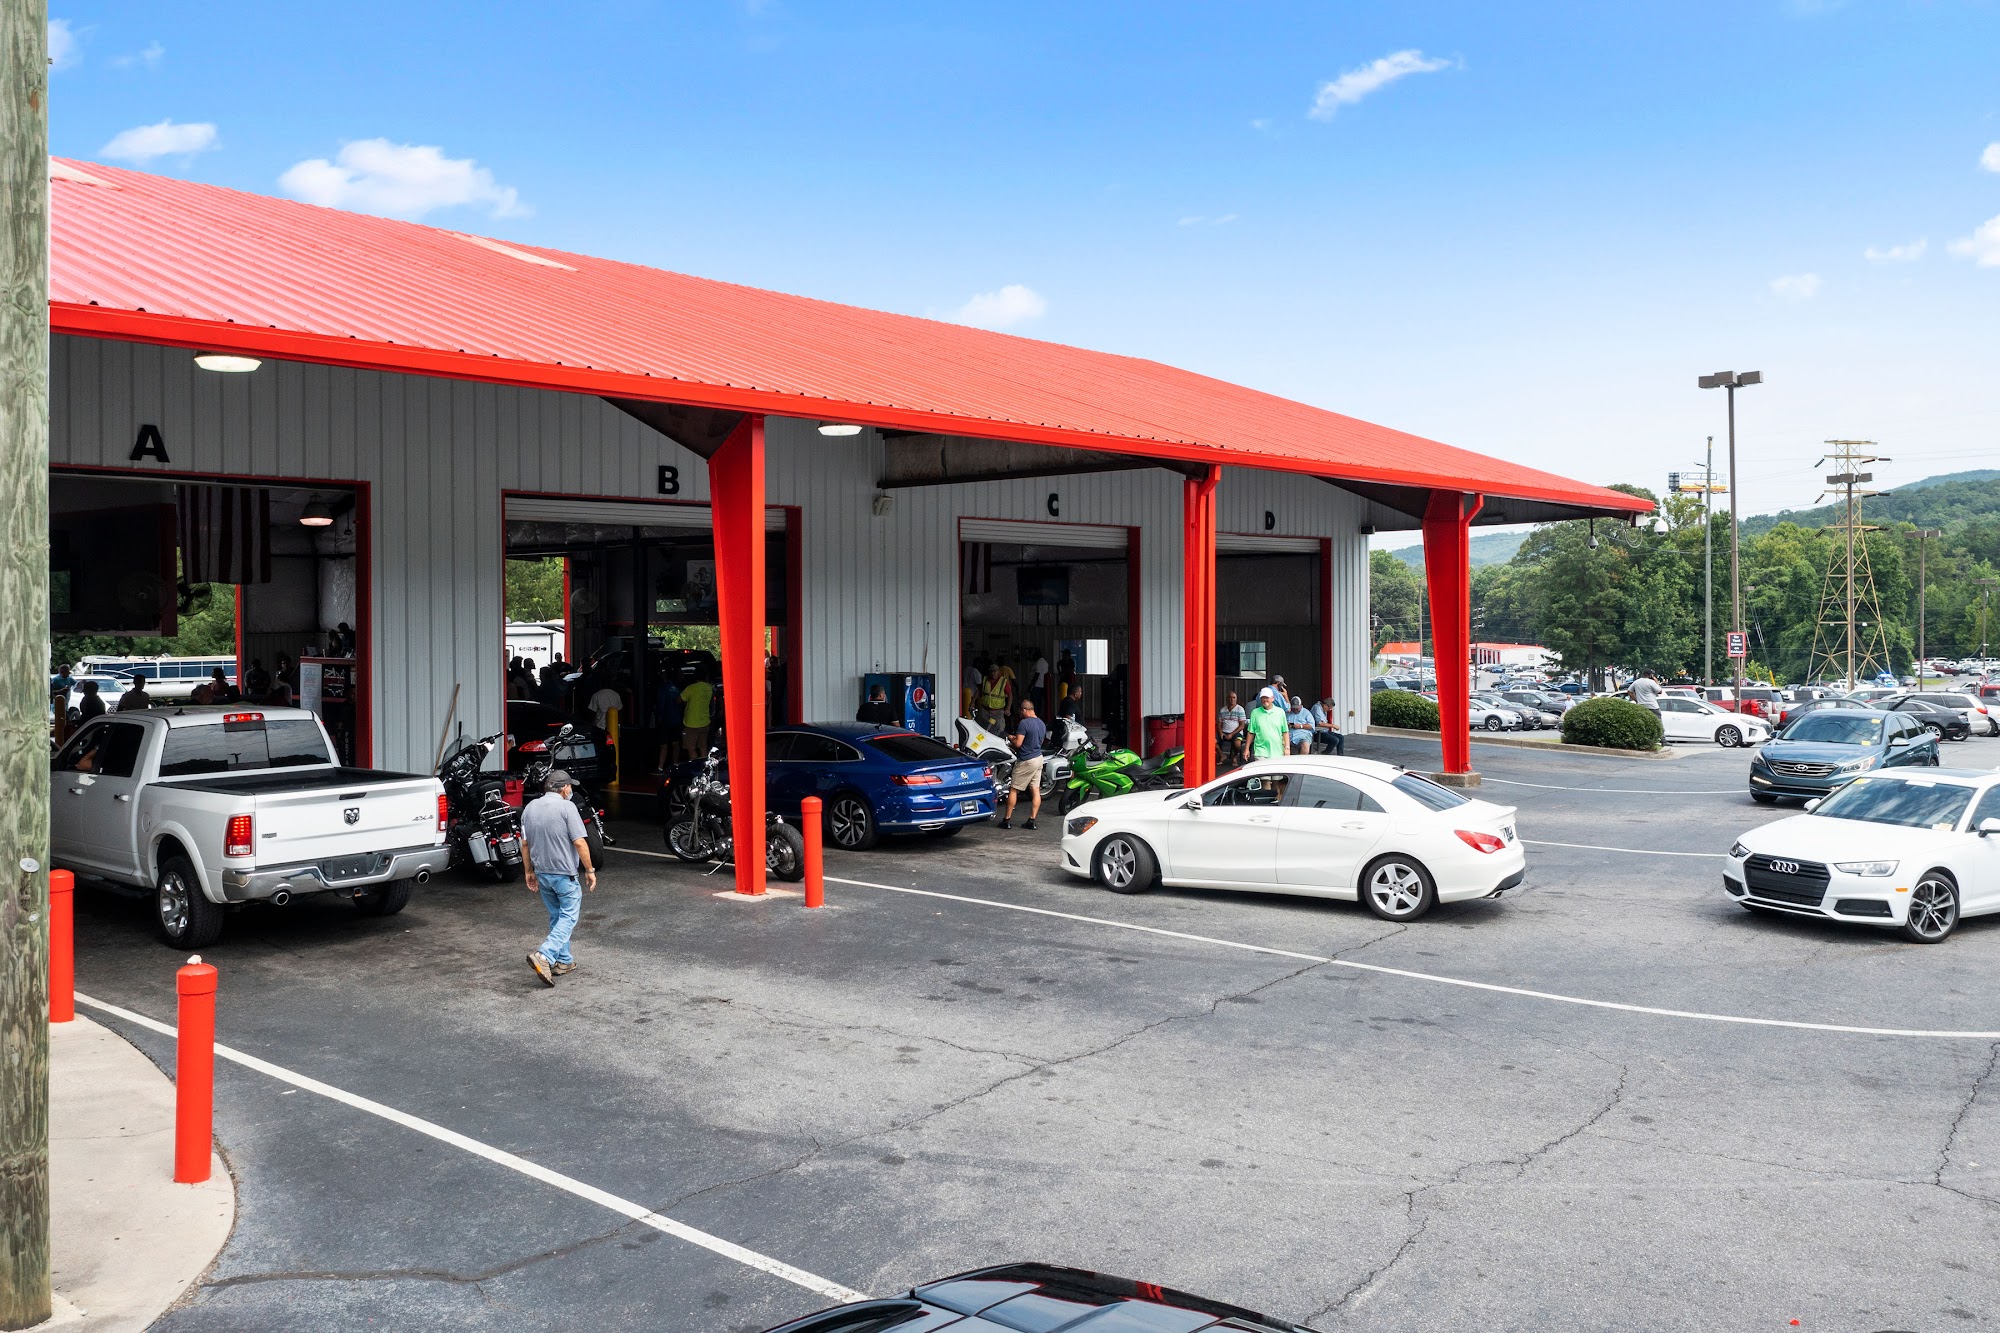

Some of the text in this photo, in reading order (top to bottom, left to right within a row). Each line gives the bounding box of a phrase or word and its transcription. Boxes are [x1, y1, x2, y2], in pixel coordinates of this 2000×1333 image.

[130, 424, 171, 463] A
[658, 465, 680, 494] B
[1047, 493, 1059, 517] C
[1265, 510, 1275, 530] D
